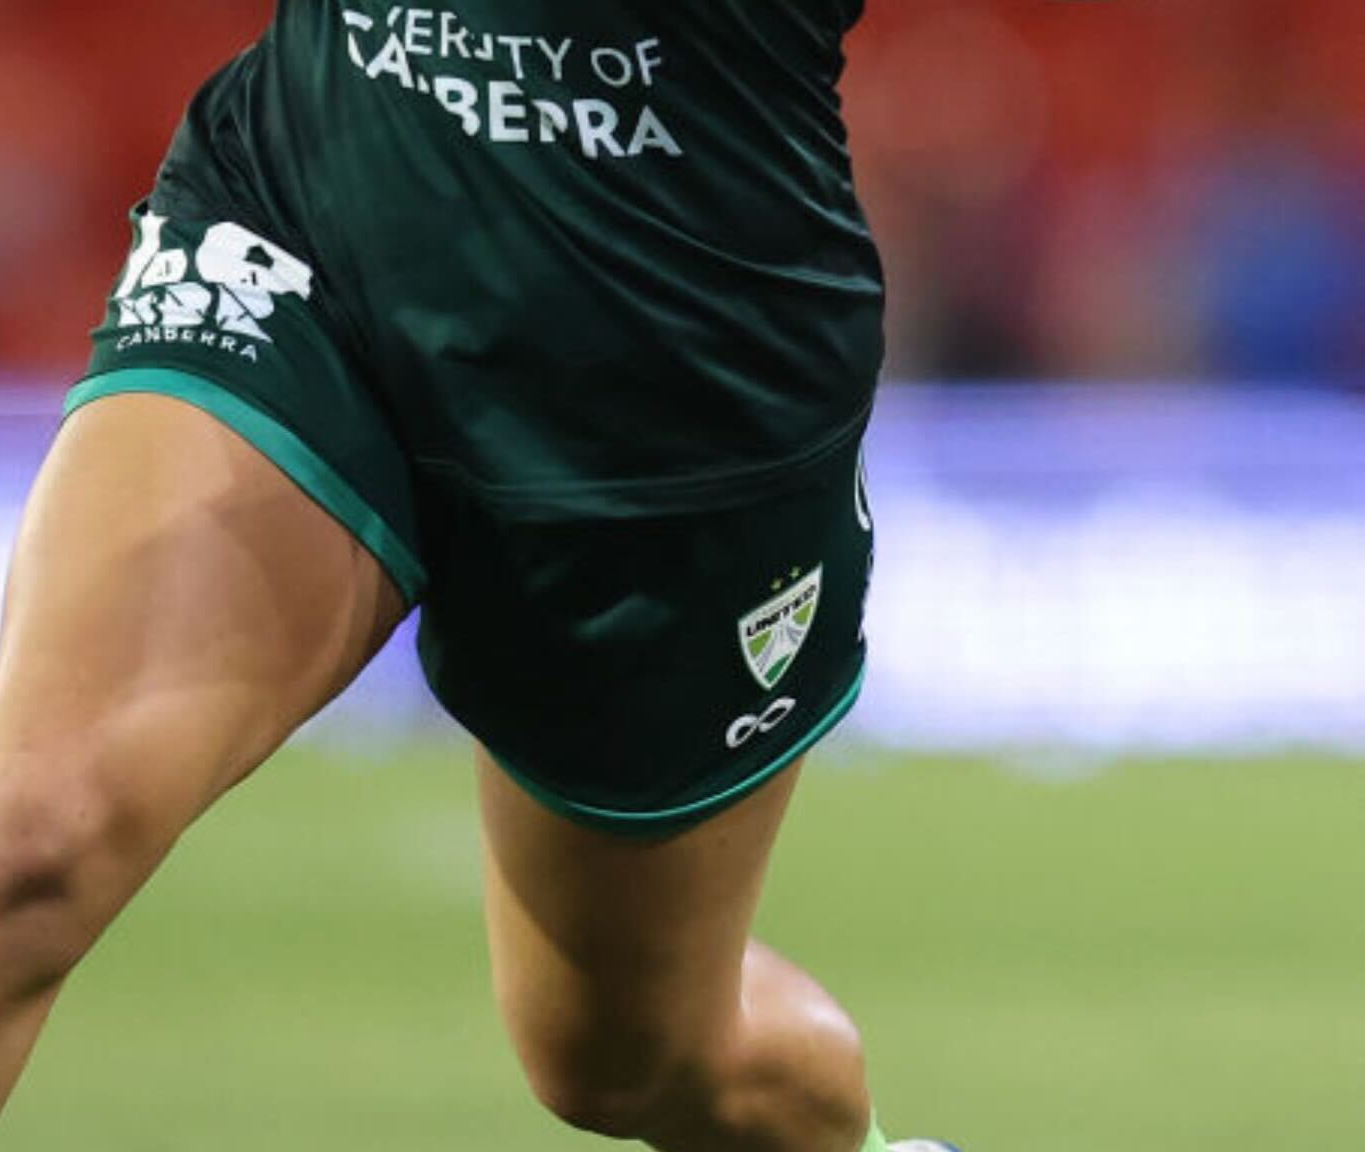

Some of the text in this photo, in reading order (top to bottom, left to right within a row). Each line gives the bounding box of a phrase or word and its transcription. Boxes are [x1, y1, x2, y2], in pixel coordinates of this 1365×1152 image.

[589, 38, 663, 88] OF
[116, 326, 258, 363] CANBERRA
[746, 583, 817, 638] UNITED
